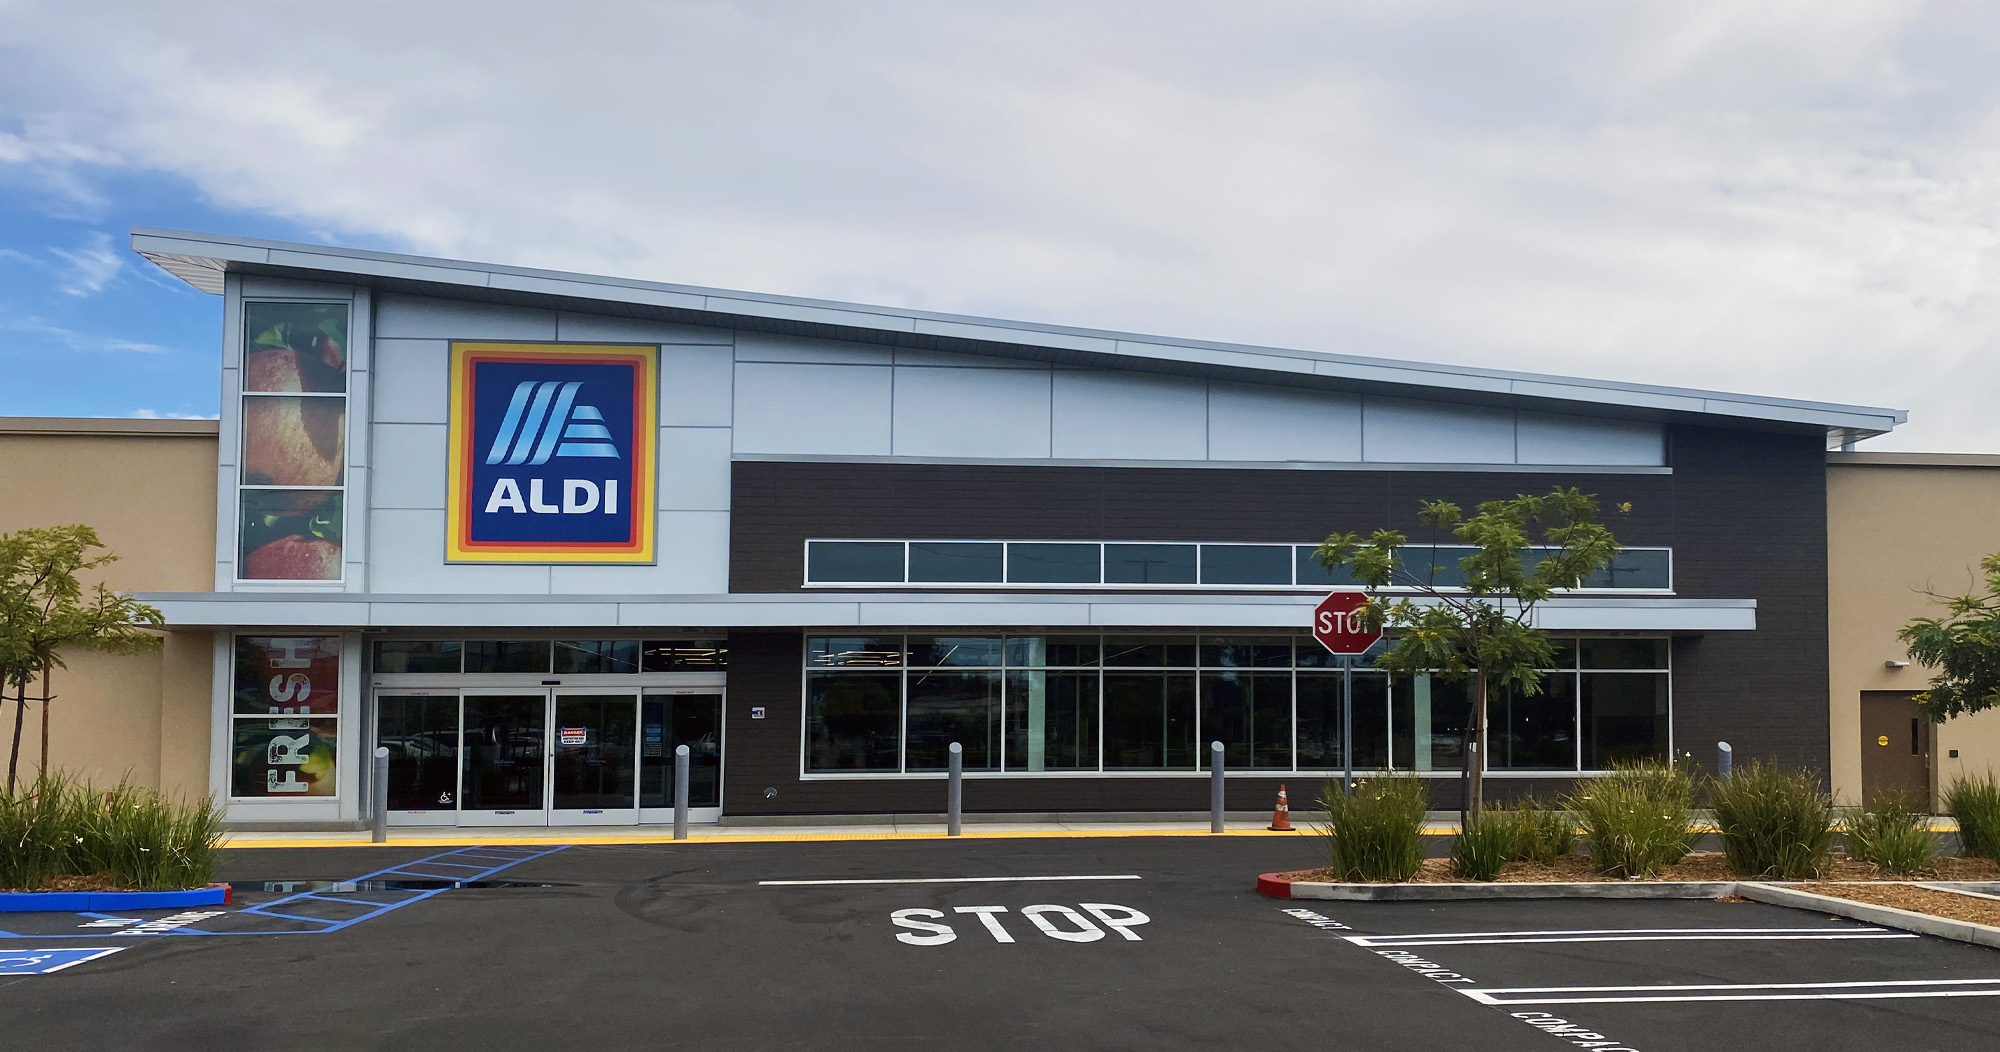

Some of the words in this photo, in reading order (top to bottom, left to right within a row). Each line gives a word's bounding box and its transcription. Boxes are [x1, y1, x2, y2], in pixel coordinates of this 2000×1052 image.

[484, 478, 618, 514] ALDI
[267, 637, 312, 793] FRESH
[890, 903, 1151, 946] STOP
[1375, 950, 1476, 984] COMPACT
